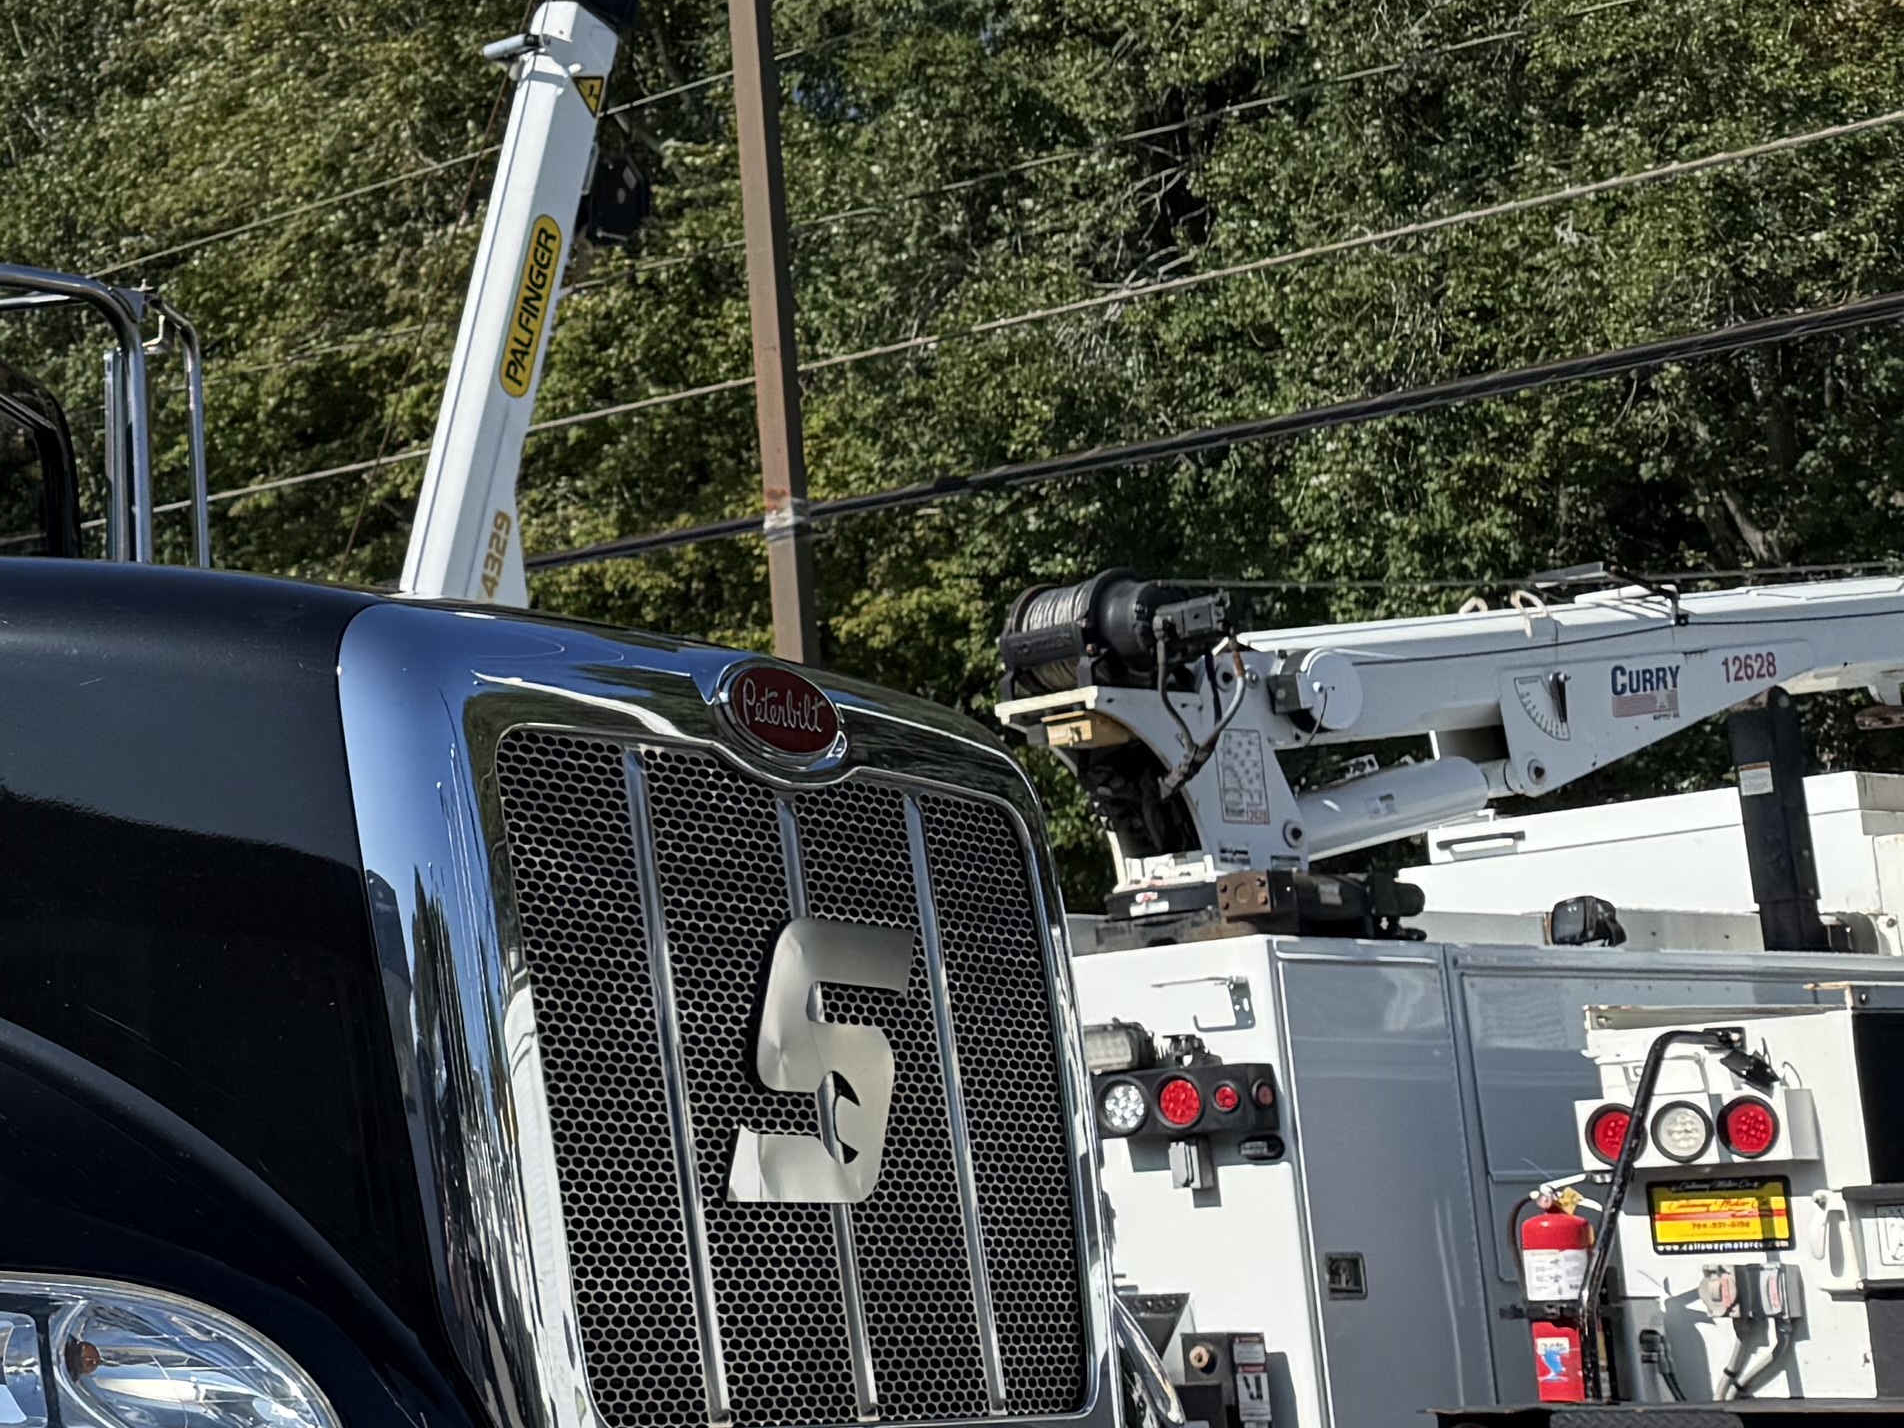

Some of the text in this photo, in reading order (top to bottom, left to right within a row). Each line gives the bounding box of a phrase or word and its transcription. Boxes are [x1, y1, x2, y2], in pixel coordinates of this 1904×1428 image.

[504, 227, 557, 387] PALFINGER
[1611, 664, 1680, 696] CURRY
[1722, 652, 1777, 683] 12628
[742, 677, 826, 733] Peterbilt
